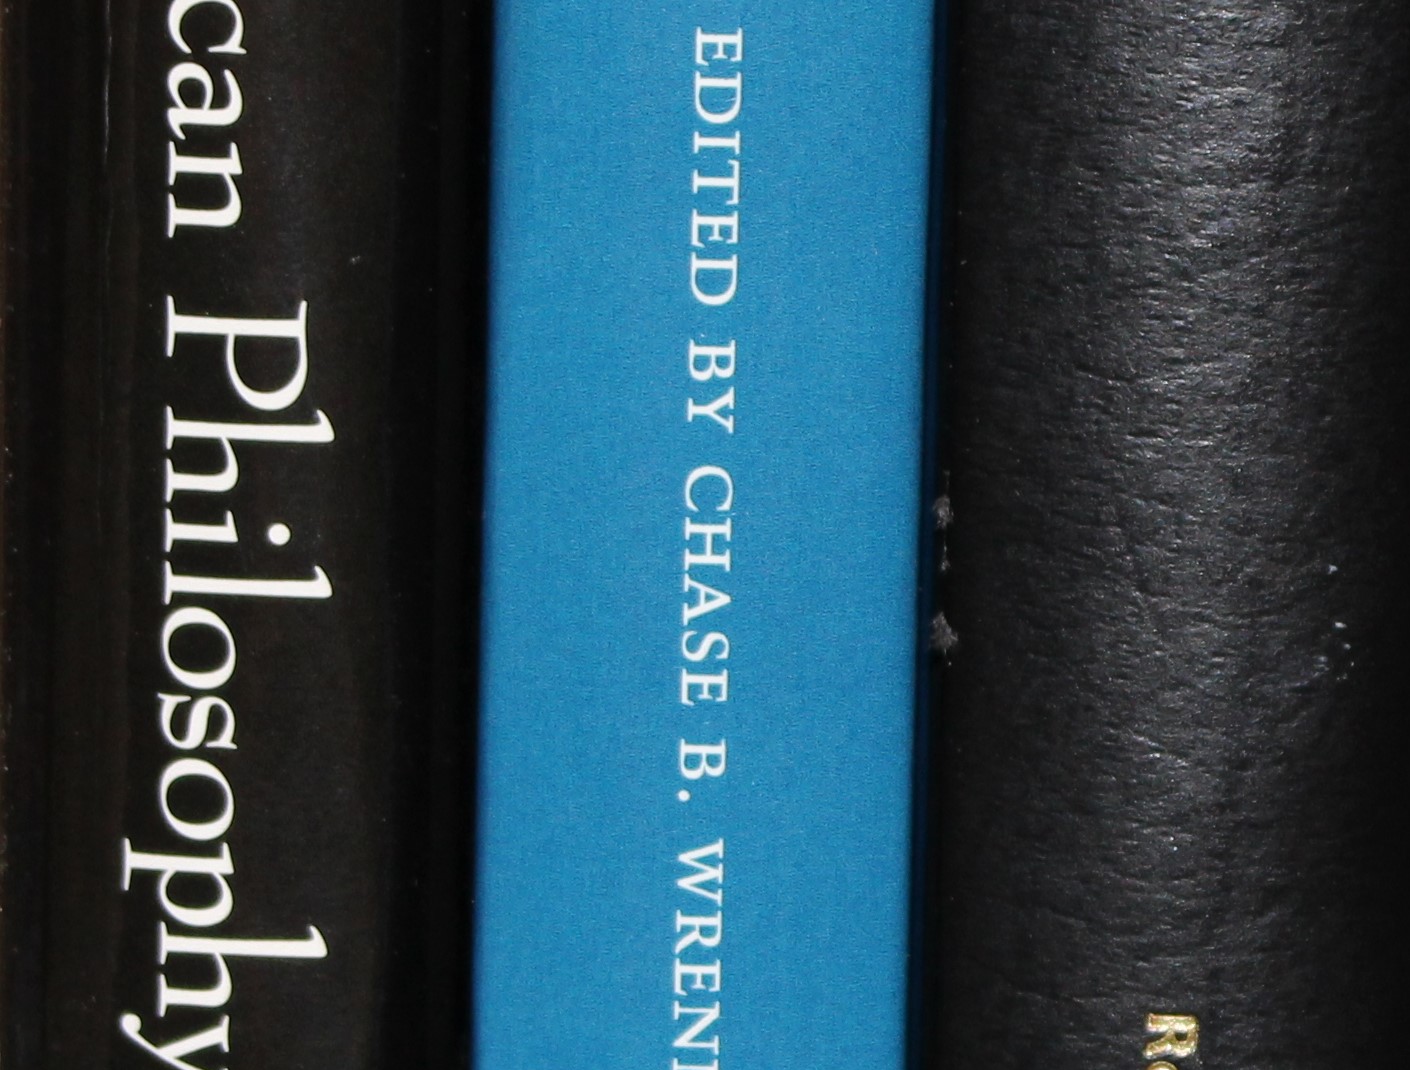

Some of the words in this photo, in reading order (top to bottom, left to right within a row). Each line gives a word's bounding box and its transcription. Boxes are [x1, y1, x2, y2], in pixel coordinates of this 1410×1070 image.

[166, 0, 247, 238] can
[690, 27, 743, 306] EDITED
[687, 340, 736, 433] BY
[680, 465, 733, 706] CHASE
[677, 739, 726, 802] B.
